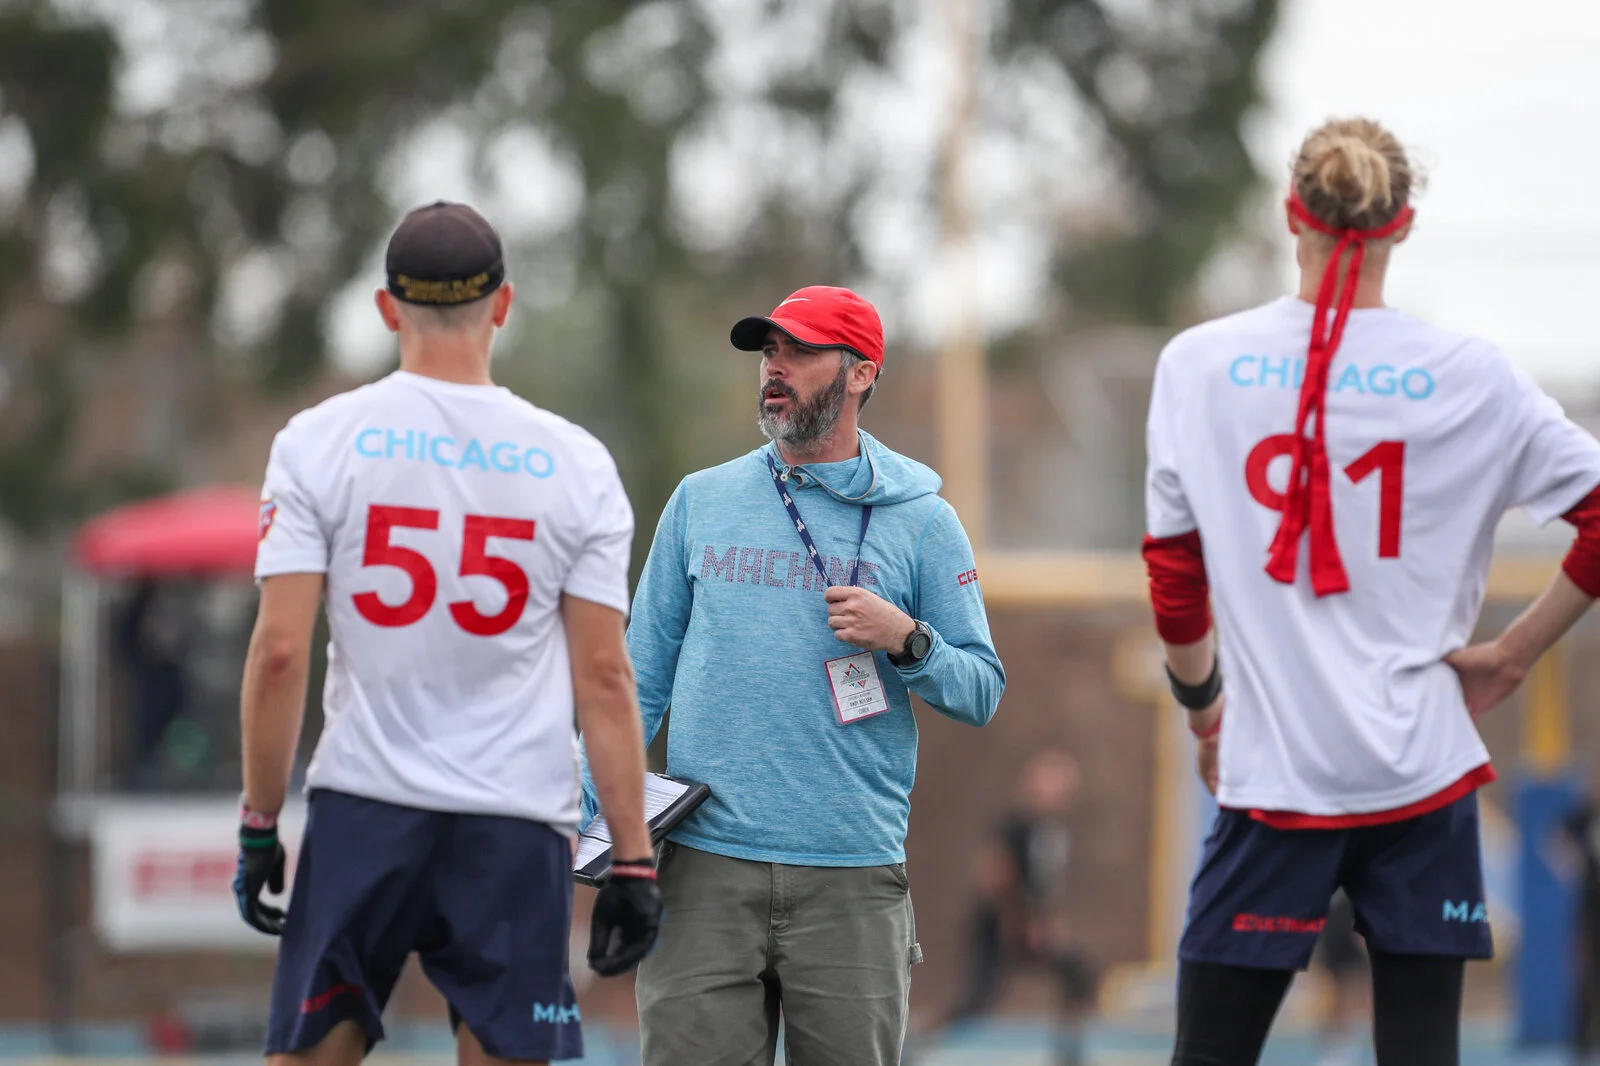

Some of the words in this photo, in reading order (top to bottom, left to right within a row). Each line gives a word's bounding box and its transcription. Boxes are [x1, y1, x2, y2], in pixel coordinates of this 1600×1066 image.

[1229, 355, 1436, 400] CHIAGO
[355, 427, 555, 480] CHICAGO
[351, 503, 536, 637] 55
